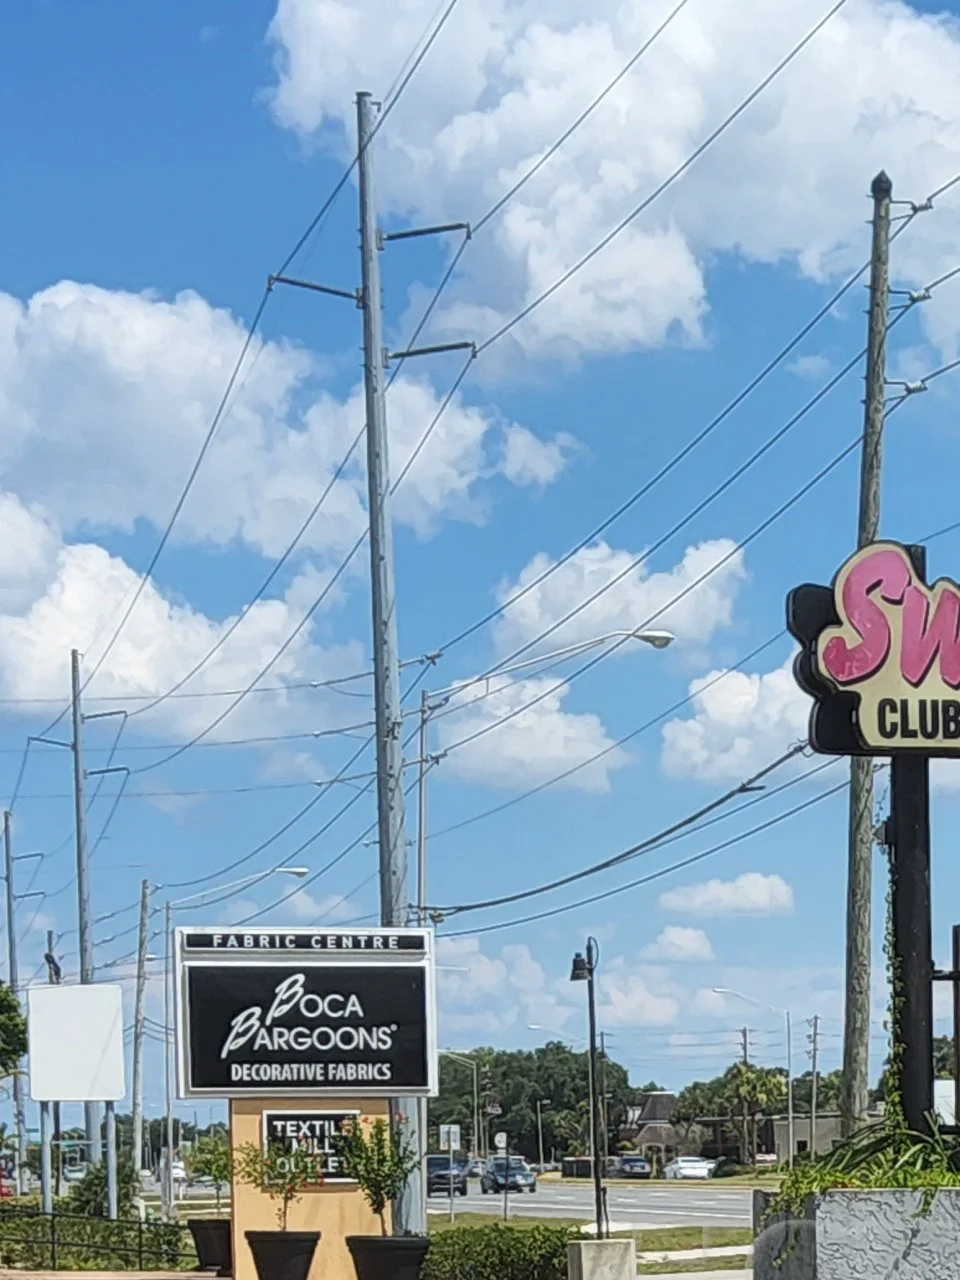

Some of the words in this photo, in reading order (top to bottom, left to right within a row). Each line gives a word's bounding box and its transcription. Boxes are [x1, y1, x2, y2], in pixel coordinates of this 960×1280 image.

[213, 935, 296, 948] FABRIC
[311, 936, 399, 949] CENTRE
[265, 973, 364, 1026] BOCA
[231, 1063, 324, 1081] DECORATIVE
[328, 1063, 391, 1080] FABRICS
[273, 1120, 353, 1136] TEXTIL
[276, 1156, 347, 1173] OUTE
